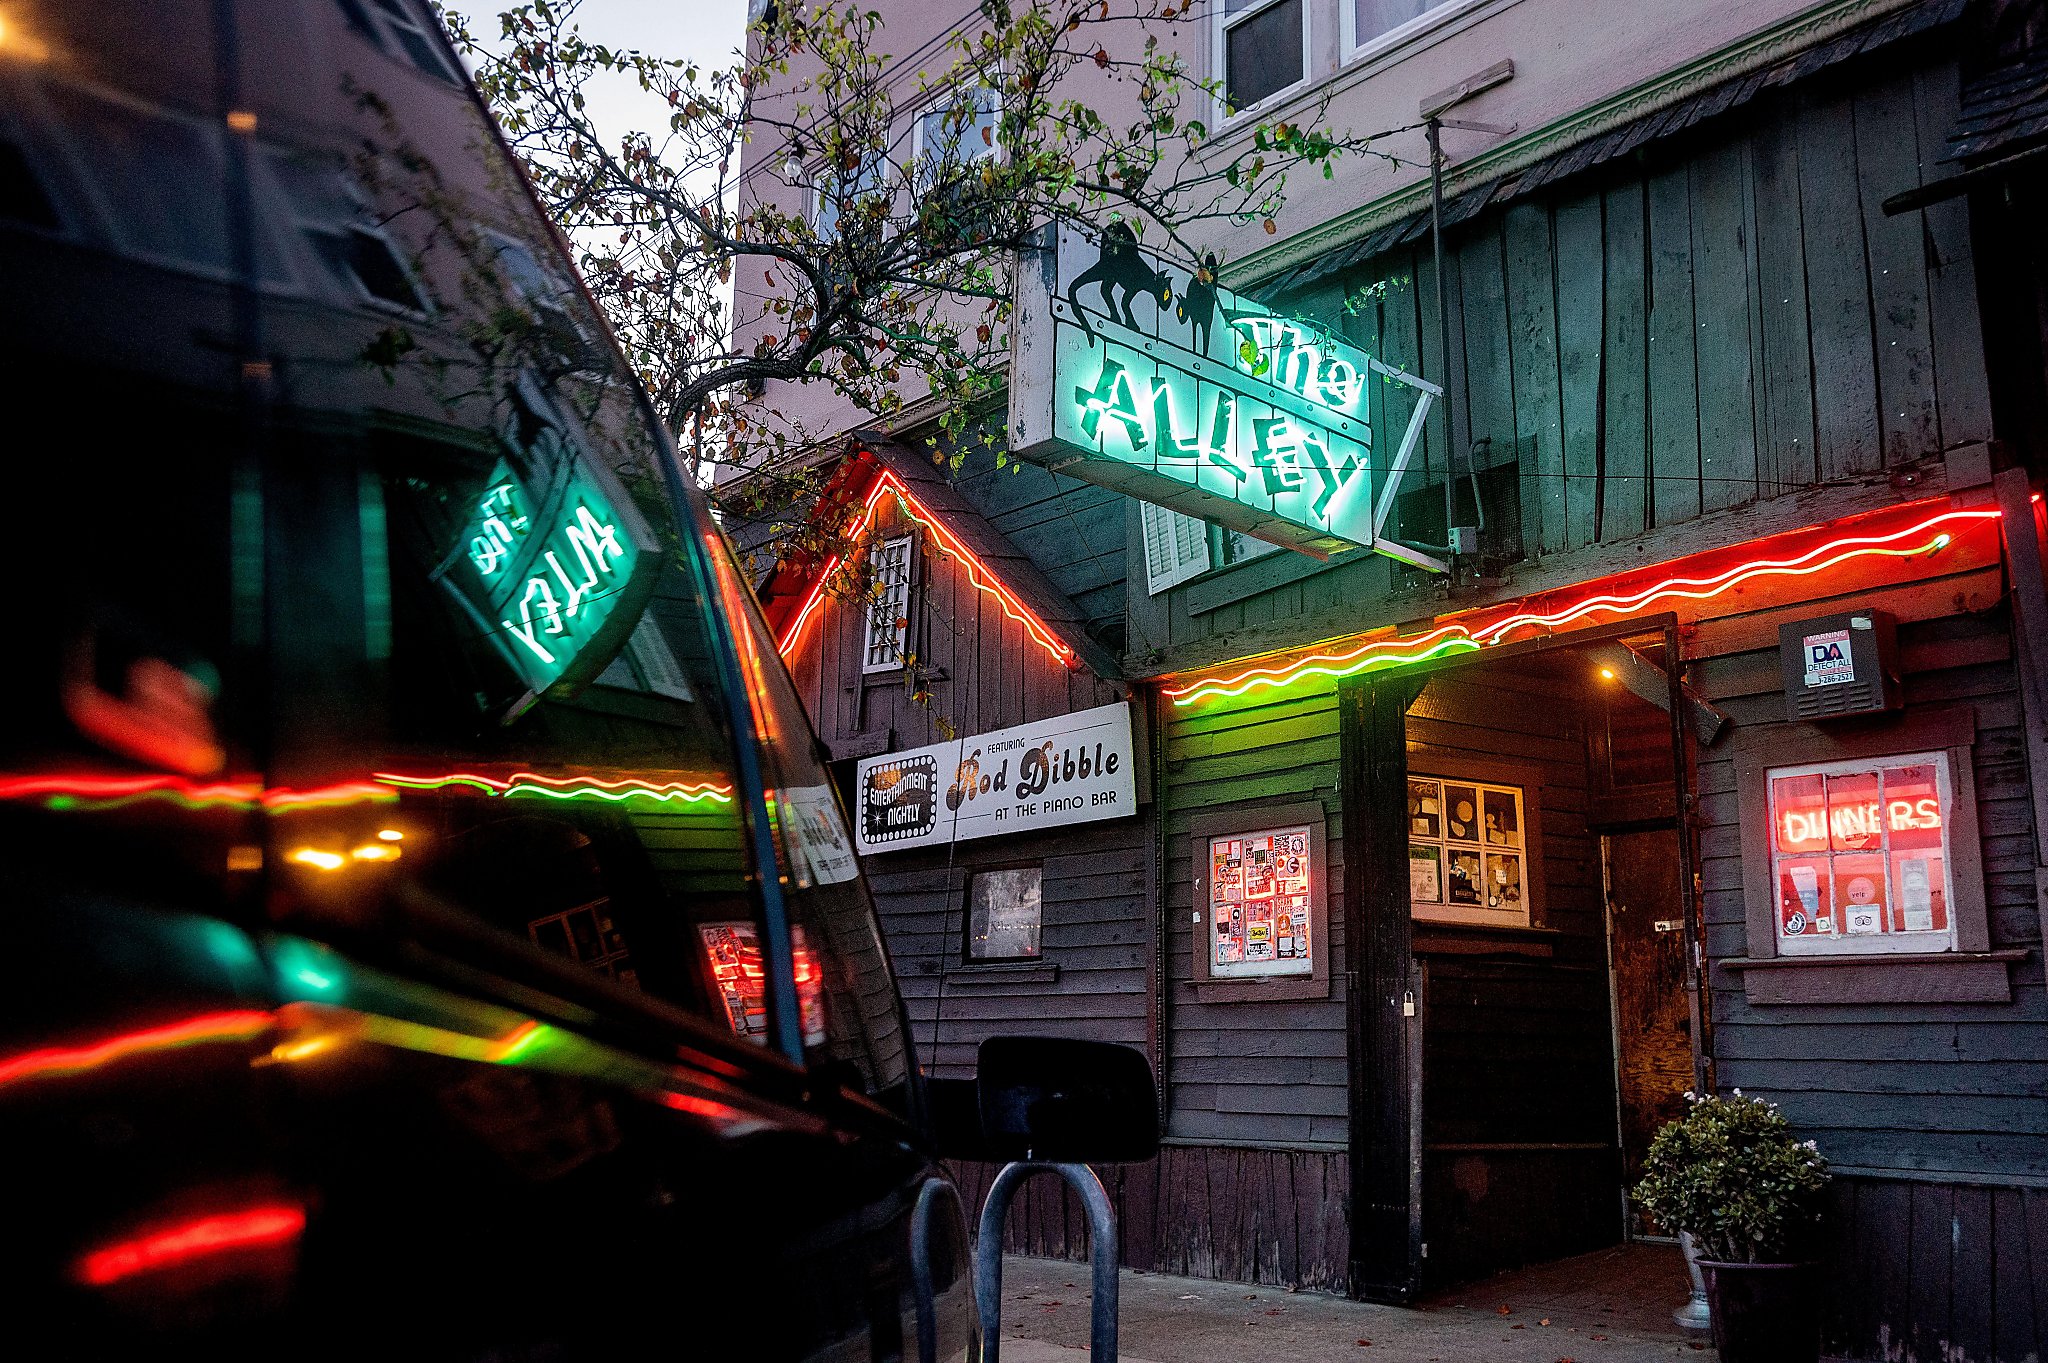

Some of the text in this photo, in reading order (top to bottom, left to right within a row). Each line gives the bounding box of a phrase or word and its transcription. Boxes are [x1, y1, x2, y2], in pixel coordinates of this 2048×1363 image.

[1226, 311, 1365, 406] The
[1075, 358, 1367, 520] ALLEY
[1807, 630, 1846, 641] WARNING
[1808, 661, 1836, 671] DETECT
[1838, 659, 1851, 667] ALL
[1812, 643, 1844, 663] DA
[987, 737, 1025, 754] FEATURING
[870, 772, 928, 806] ENTERTAINMENT
[946, 741, 1119, 811] Rod Dibble
[887, 804, 921, 827] NIGHTLY
[995, 791, 1117, 821] AT THE PIANO BAR
